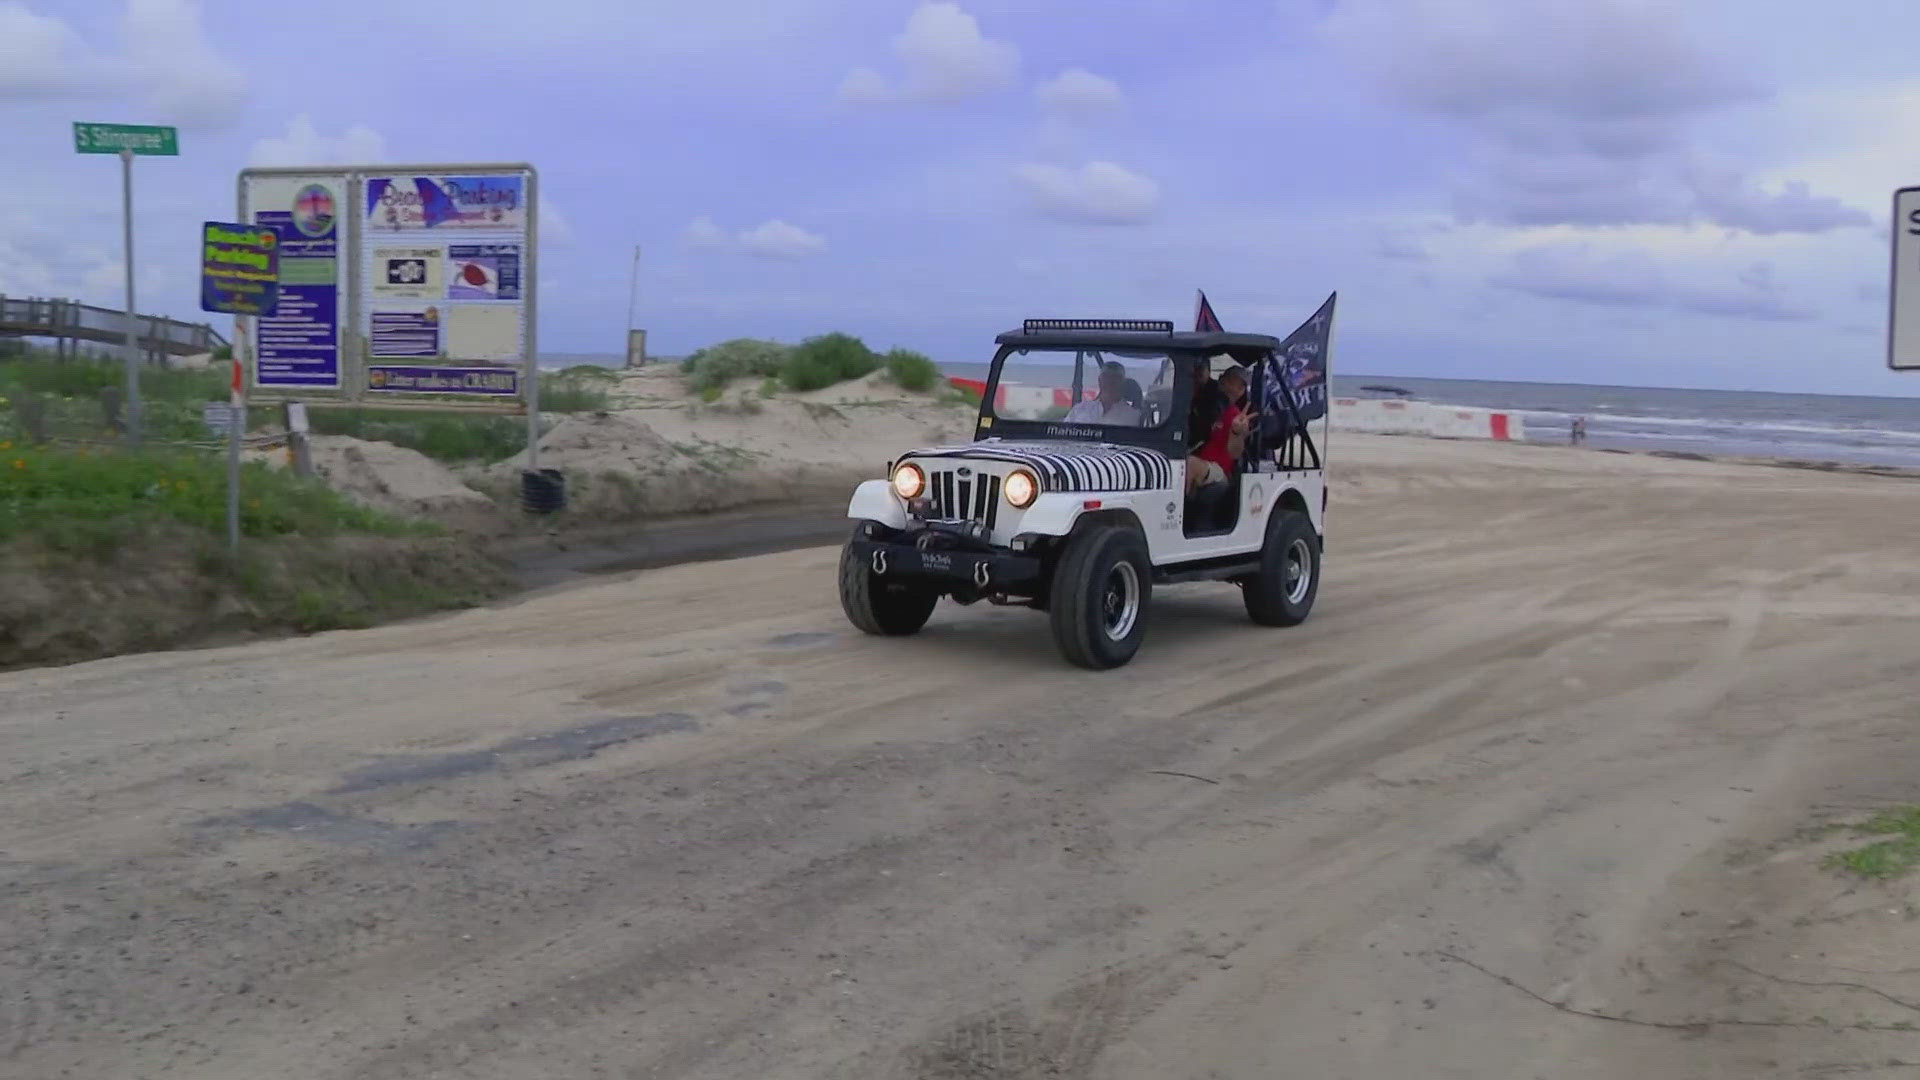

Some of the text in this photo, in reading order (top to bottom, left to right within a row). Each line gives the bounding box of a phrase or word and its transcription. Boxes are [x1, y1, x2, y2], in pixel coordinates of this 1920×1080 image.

[78, 126, 90, 147] S
[446, 181, 517, 211] Parking
[1047, 425, 1103, 438] Mahindra
